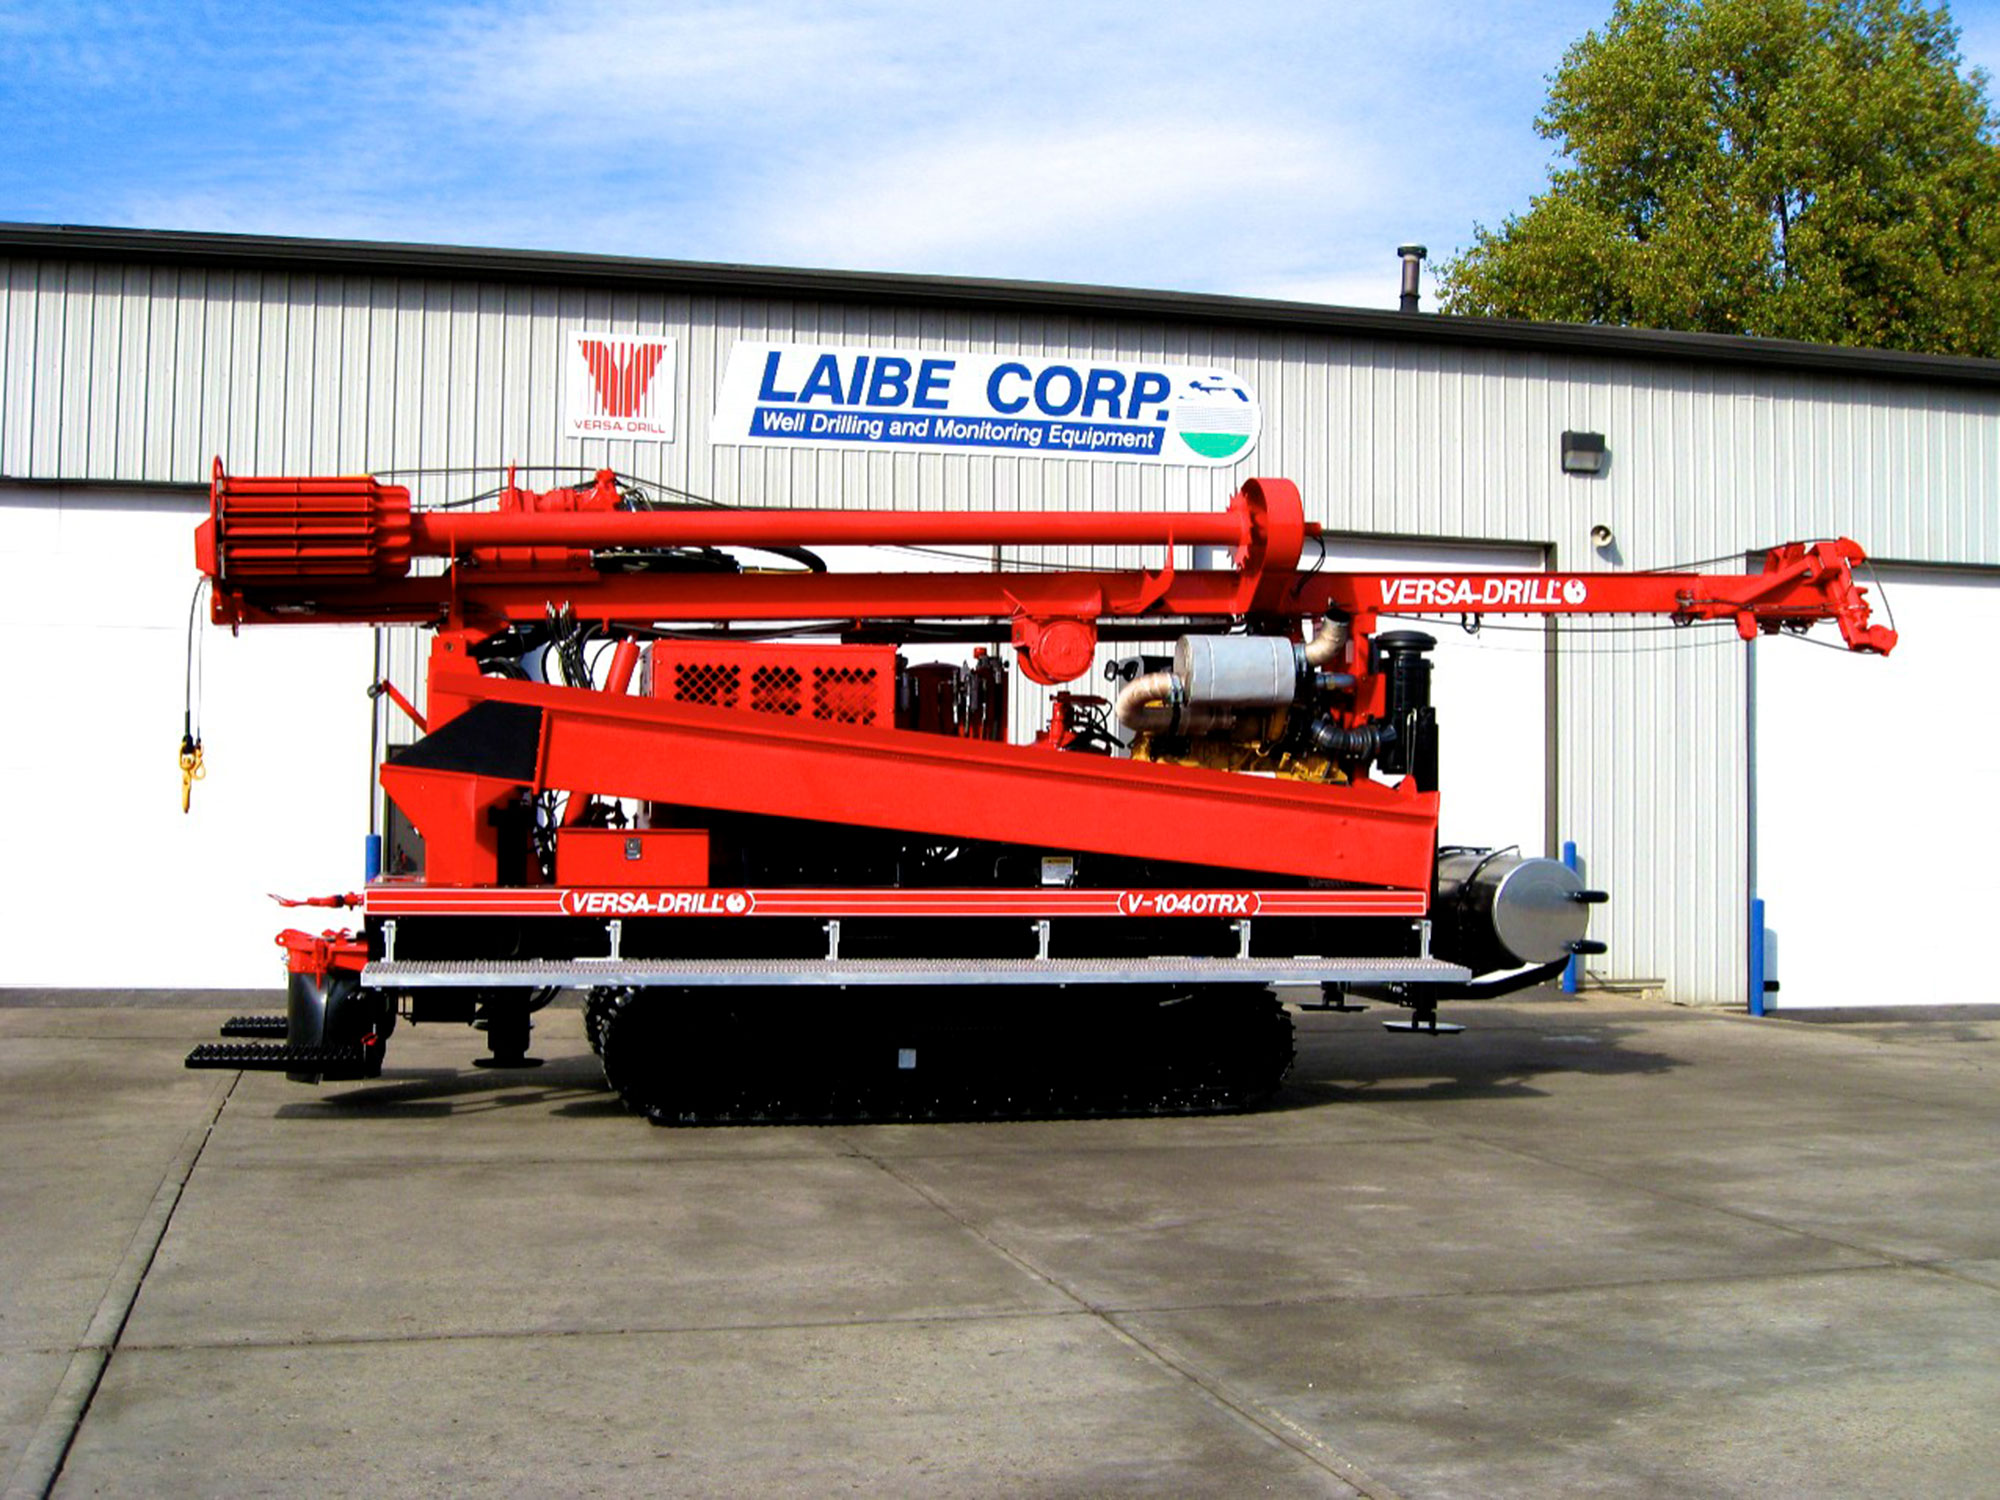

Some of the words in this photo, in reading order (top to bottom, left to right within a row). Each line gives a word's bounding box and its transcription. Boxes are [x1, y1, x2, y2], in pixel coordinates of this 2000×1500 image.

[758, 351, 956, 410] LAIBE
[986, 362, 1170, 421] CORP.
[573, 419, 624, 431] VERSA
[626, 421, 667, 434] DRILL
[763, 411, 806, 432] Well
[810, 414, 884, 439] Drilling
[889, 418, 930, 437] and
[934, 420, 1043, 447] Monitoring
[1048, 424, 1156, 450] Equipment
[1380, 578, 1562, 605] VERSA-DRILL
[572, 893, 727, 913] VERSA-DRILL
[1127, 894, 1250, 913] V-1040TRX
